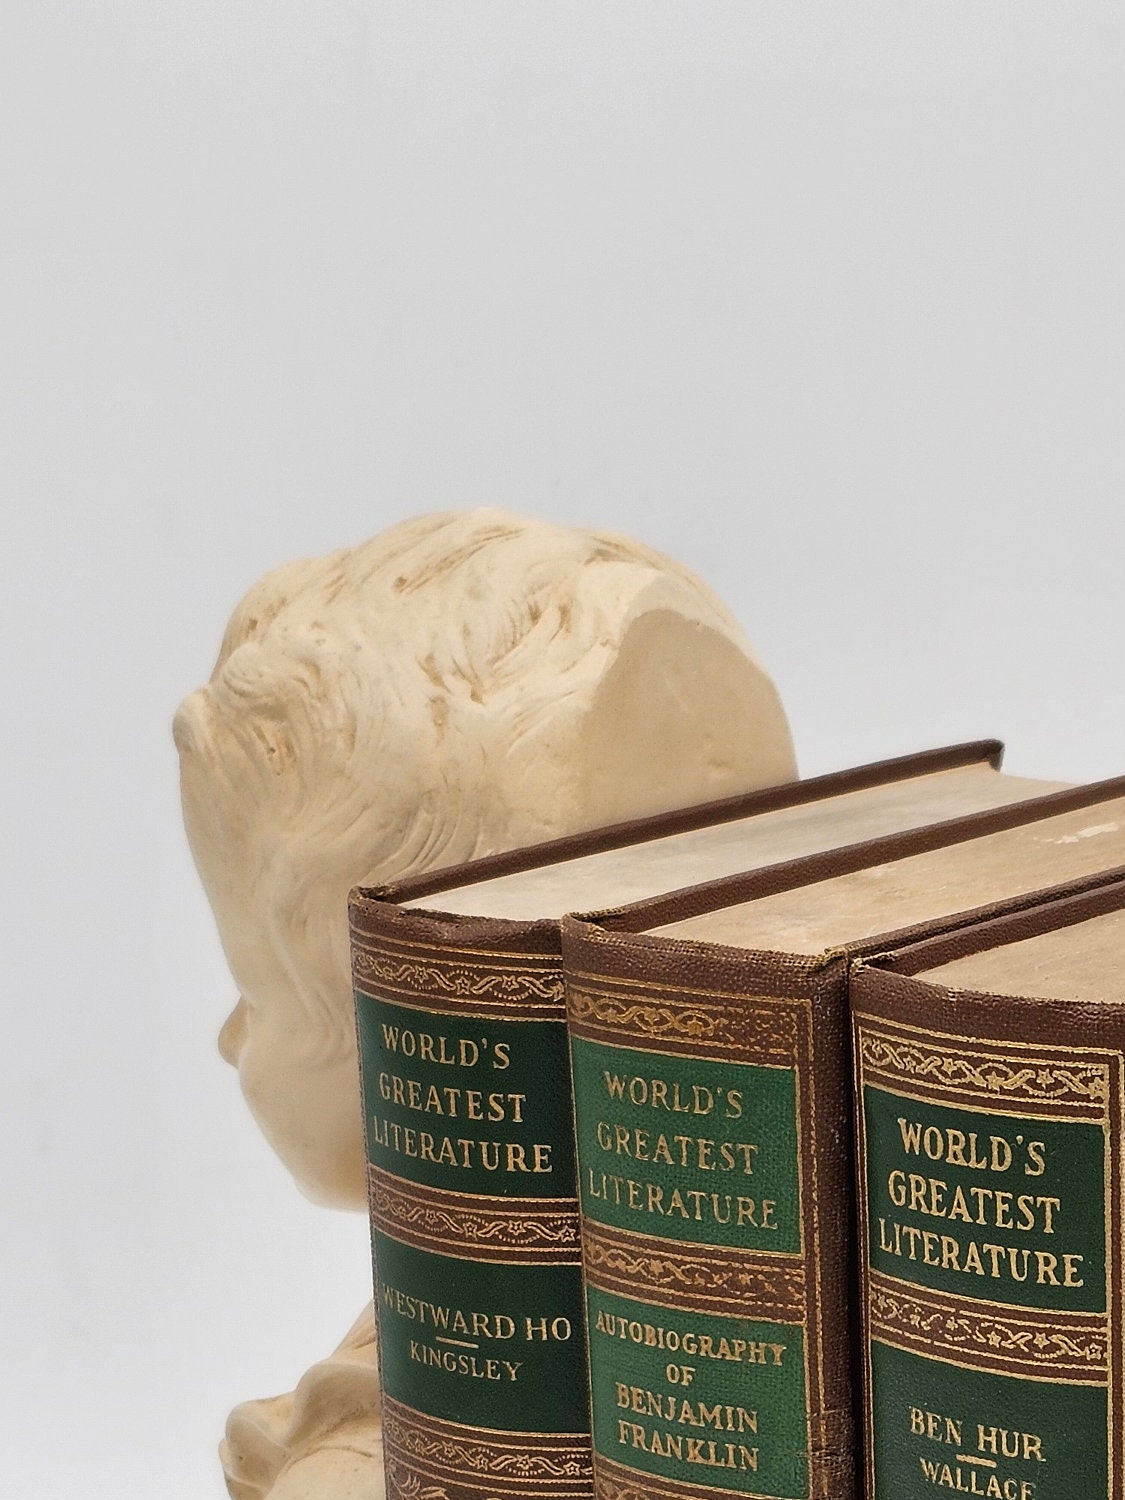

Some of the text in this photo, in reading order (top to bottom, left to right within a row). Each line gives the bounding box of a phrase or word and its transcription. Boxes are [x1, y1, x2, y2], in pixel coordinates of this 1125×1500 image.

[381, 1023, 511, 1069] WORLD'S
[379, 1072, 527, 1123] GREATEST
[603, 1070, 744, 1119] WORLD'S
[373, 1115, 553, 1173] LITERATURE
[597, 1121, 759, 1175] GREATEST
[897, 1117, 1046, 1176] WORLD'S
[588, 1168, 778, 1230] LITERATURE
[887, 1170, 1061, 1234] GREATEST
[878, 1217, 1084, 1287] LITERATURE
[381, 1282, 572, 1341] WESTWARD HO
[595, 1310, 787, 1366] AUTOBIOGRAPHY
[410, 1339, 523, 1382] KINGSLEY
[665, 1363, 696, 1386] OF
[615, 1382, 758, 1434] BENJAMIN
[909, 1405, 1047, 1462] BEN HUR
[617, 1419, 760, 1472] FRANKLIN
